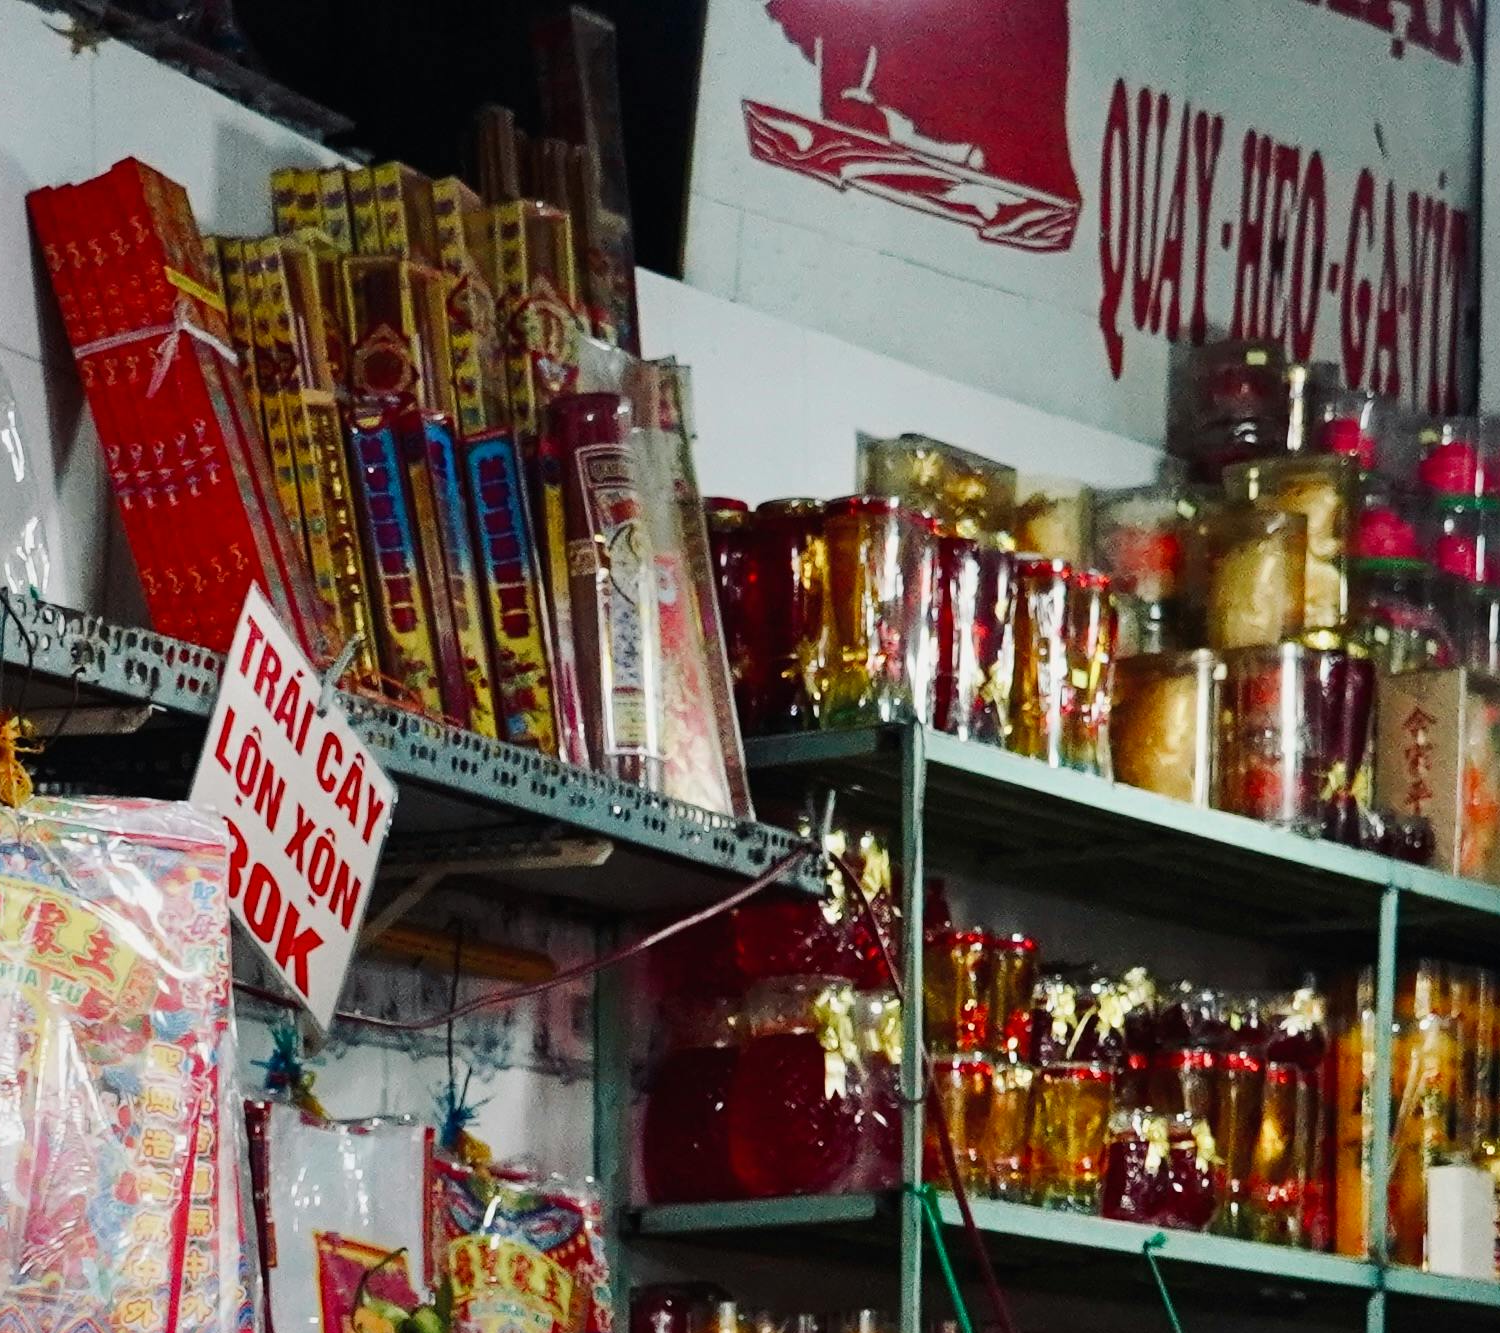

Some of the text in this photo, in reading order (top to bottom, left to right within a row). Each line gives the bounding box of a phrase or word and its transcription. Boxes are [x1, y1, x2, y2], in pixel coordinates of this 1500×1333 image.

[214, 705, 362, 931] LỘN XỘN
[238, 615, 384, 844] TRÁI CÂY
